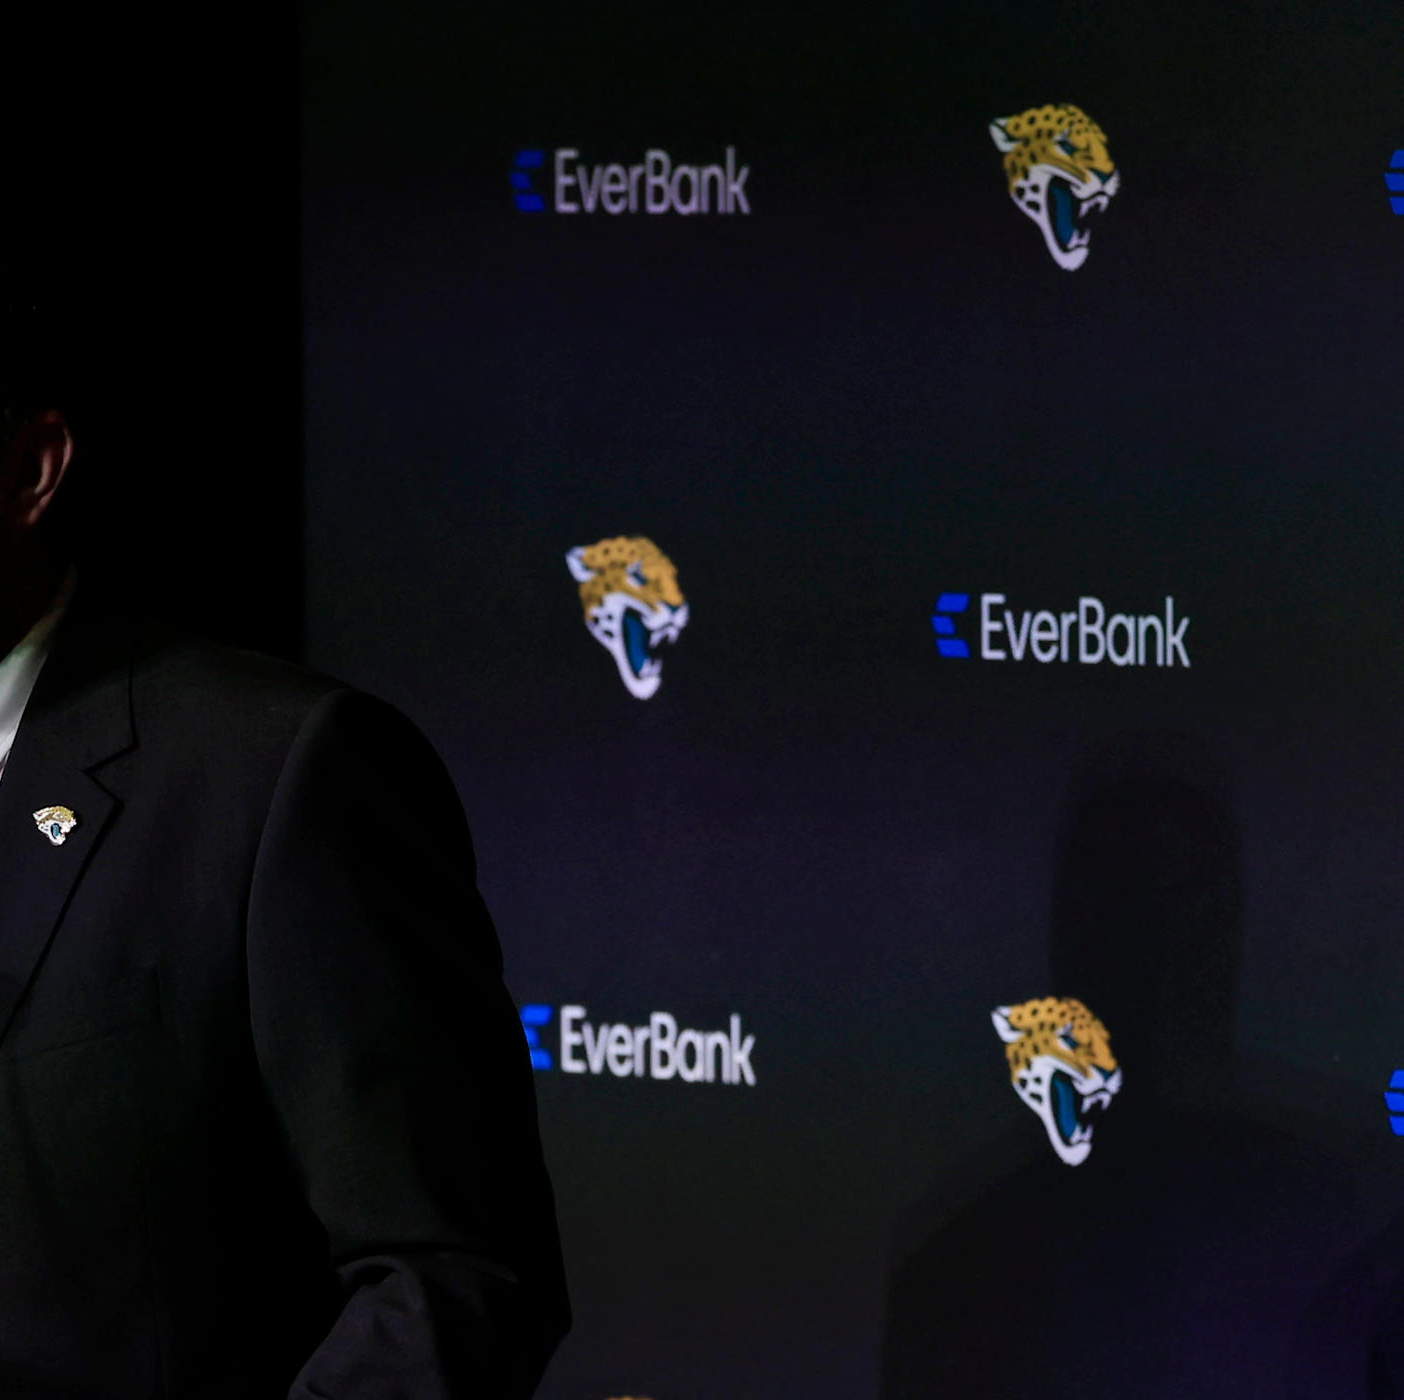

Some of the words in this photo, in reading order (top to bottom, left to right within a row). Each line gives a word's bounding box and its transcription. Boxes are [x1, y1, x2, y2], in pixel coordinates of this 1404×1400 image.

[554, 147, 750, 216] EverBank
[980, 593, 1190, 668] EverBank
[560, 1005, 756, 1086] EverBank
